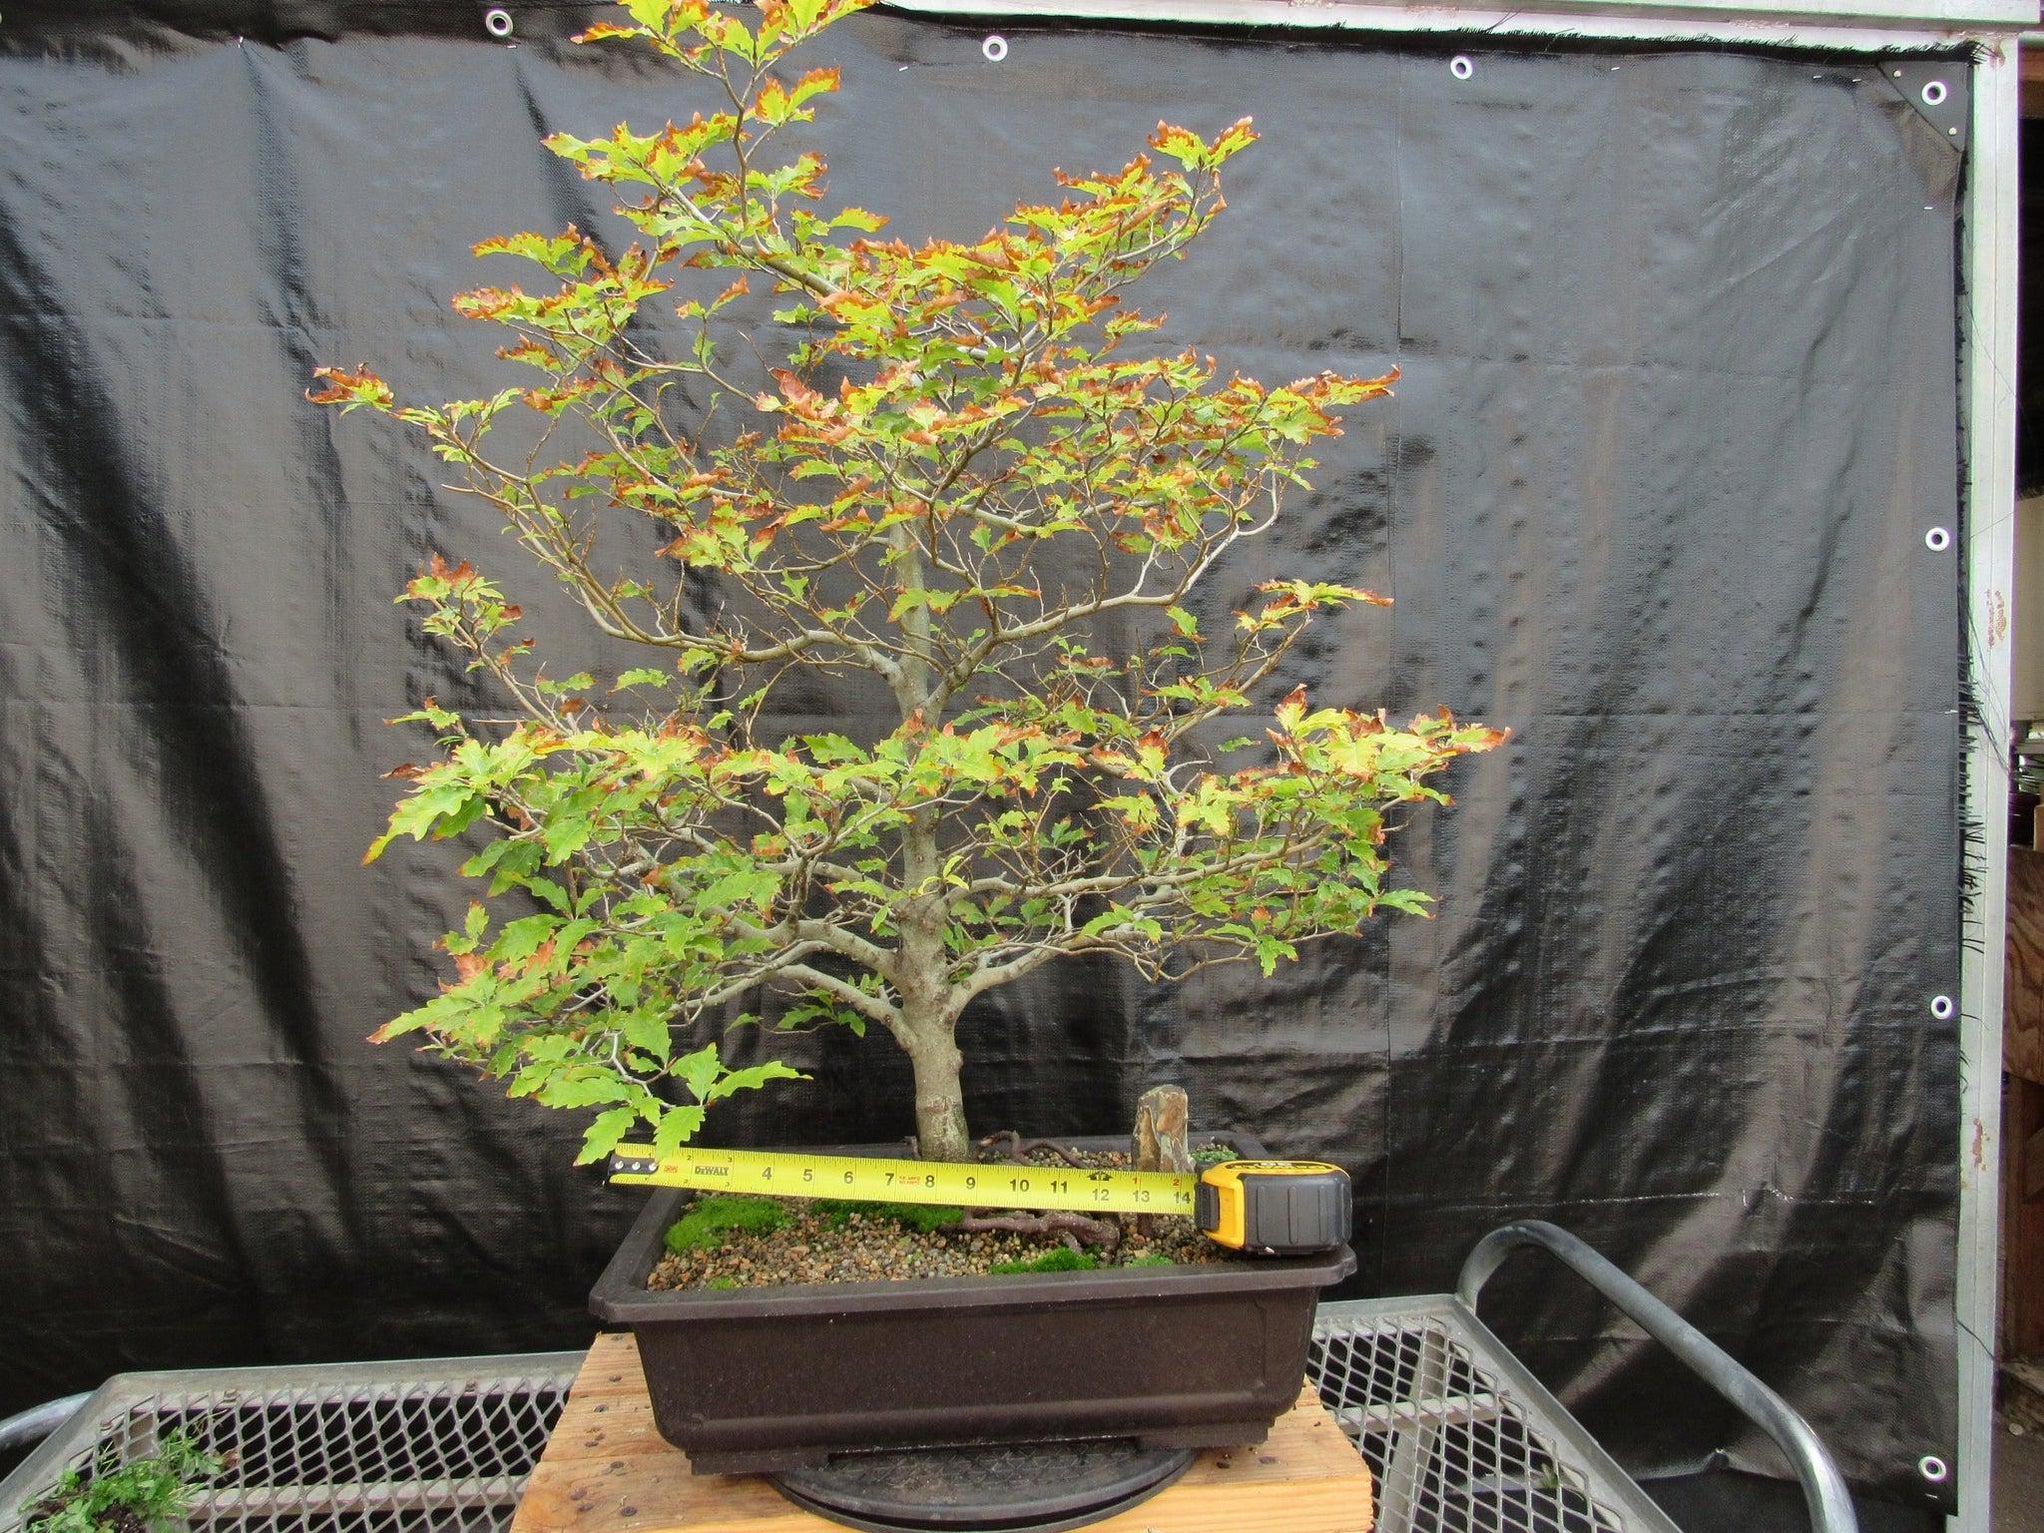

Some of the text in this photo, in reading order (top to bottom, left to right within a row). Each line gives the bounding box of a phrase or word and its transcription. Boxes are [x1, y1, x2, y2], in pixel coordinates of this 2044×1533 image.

[762, 1167, 773, 1180] 4
[803, 1168, 813, 1182] 5
[844, 1171, 854, 1184] 6
[885, 1172, 895, 1186] 7
[925, 1174, 935, 1188] 8
[966, 1176, 976, 1190] 9
[1009, 1178, 1030, 1192] 10
[1050, 1180, 1068, 1194] 11
[1092, 1188, 1110, 1201] 12
[1132, 1190, 1150, 1203] 13
[1173, 1191, 1191, 1204] 14
